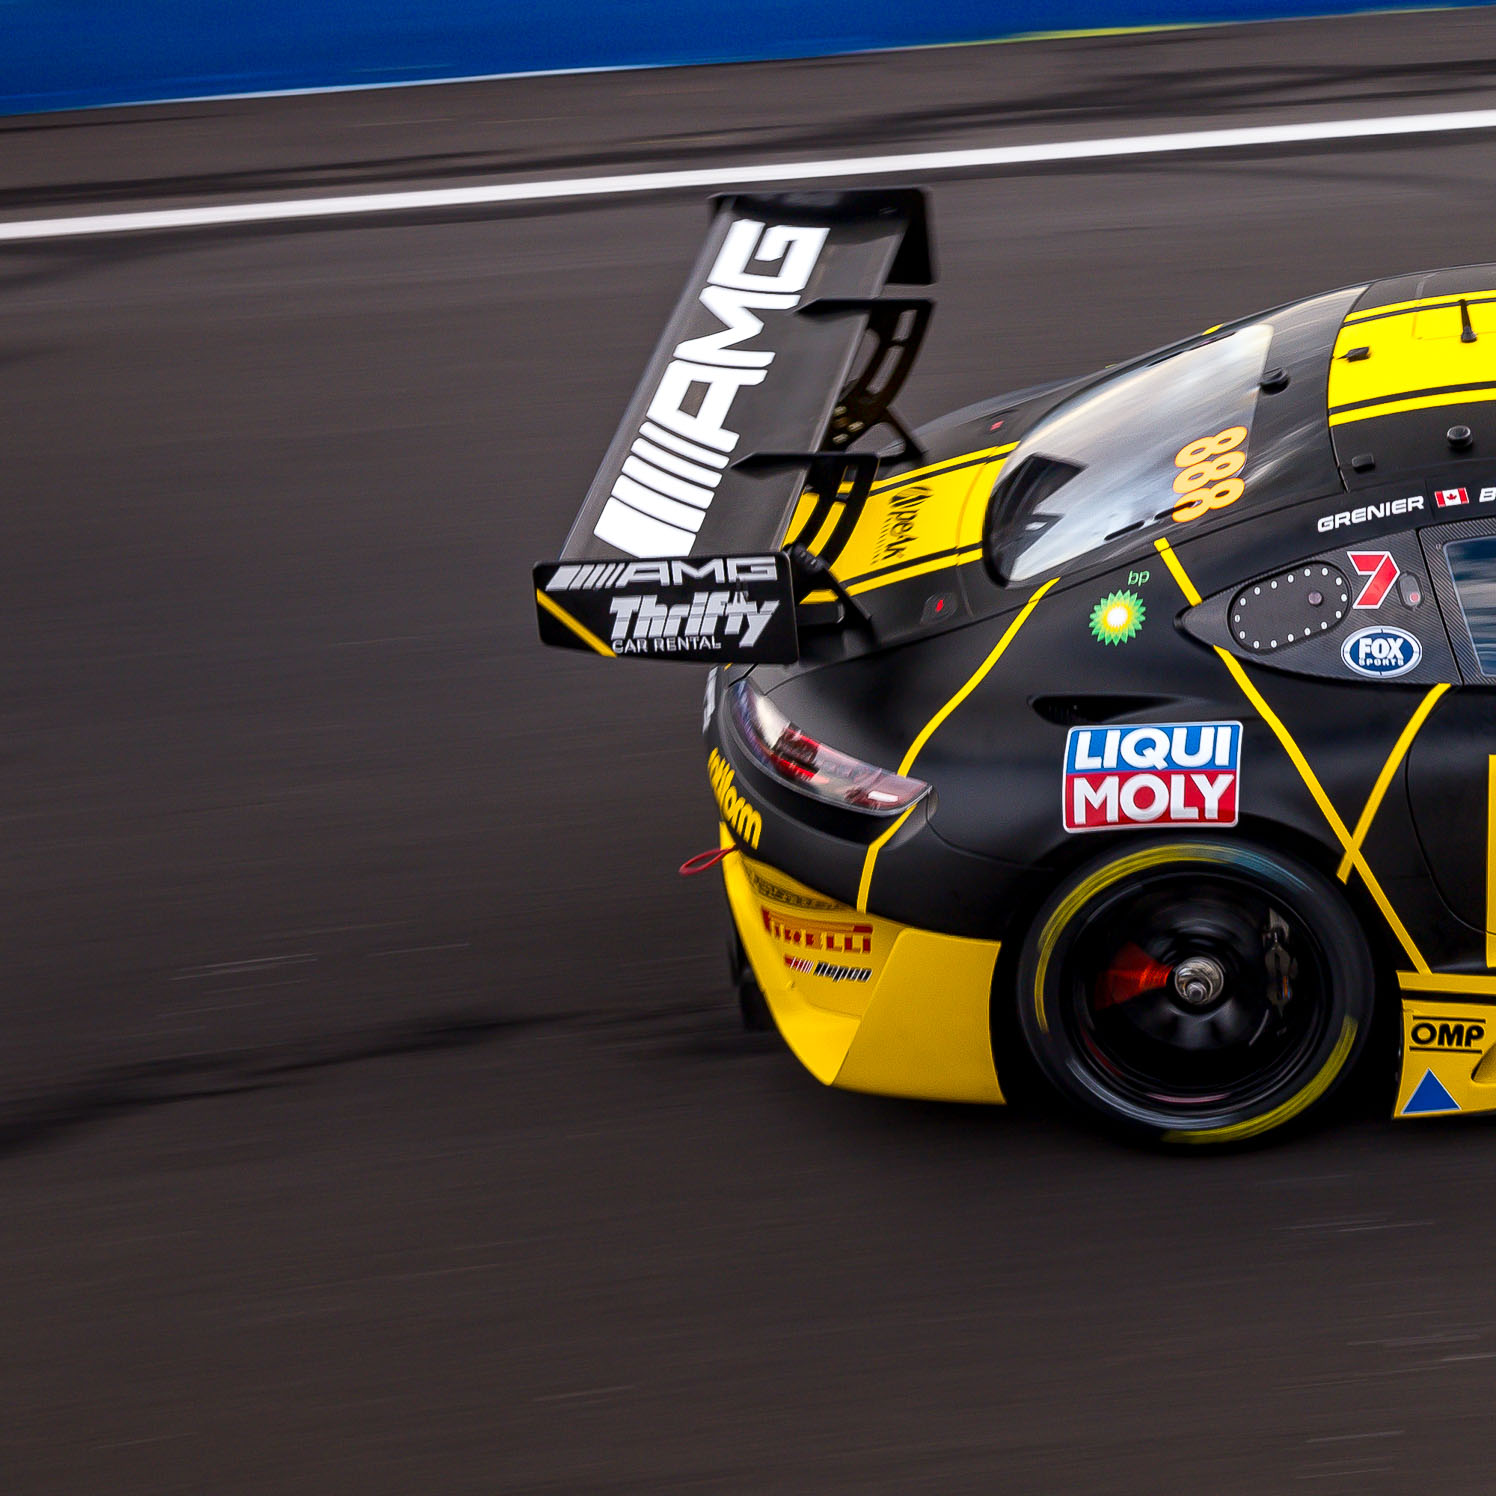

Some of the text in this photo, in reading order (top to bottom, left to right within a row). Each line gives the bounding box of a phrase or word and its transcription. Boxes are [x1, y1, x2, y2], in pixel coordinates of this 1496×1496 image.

[639, 218, 830, 468] AMG
[1171, 425, 1248, 522] 888
[1317, 495, 1425, 532] GRENIER
[615, 556, 778, 588] AMG
[1128, 570, 1150, 587] bp
[1346, 550, 1401, 609] 7
[609, 590, 780, 648] Thrifty
[612, 638, 648, 654] CAR
[654, 635, 722, 653] RENTAL
[1358, 637, 1405, 659] FOX
[1358, 657, 1405, 666] SPORTS
[1075, 726, 1232, 770] LIQUI
[1073, 773, 1235, 825] MOLY
[762, 905, 874, 954] PIRELLI
[1410, 1022, 1485, 1048] OMP
